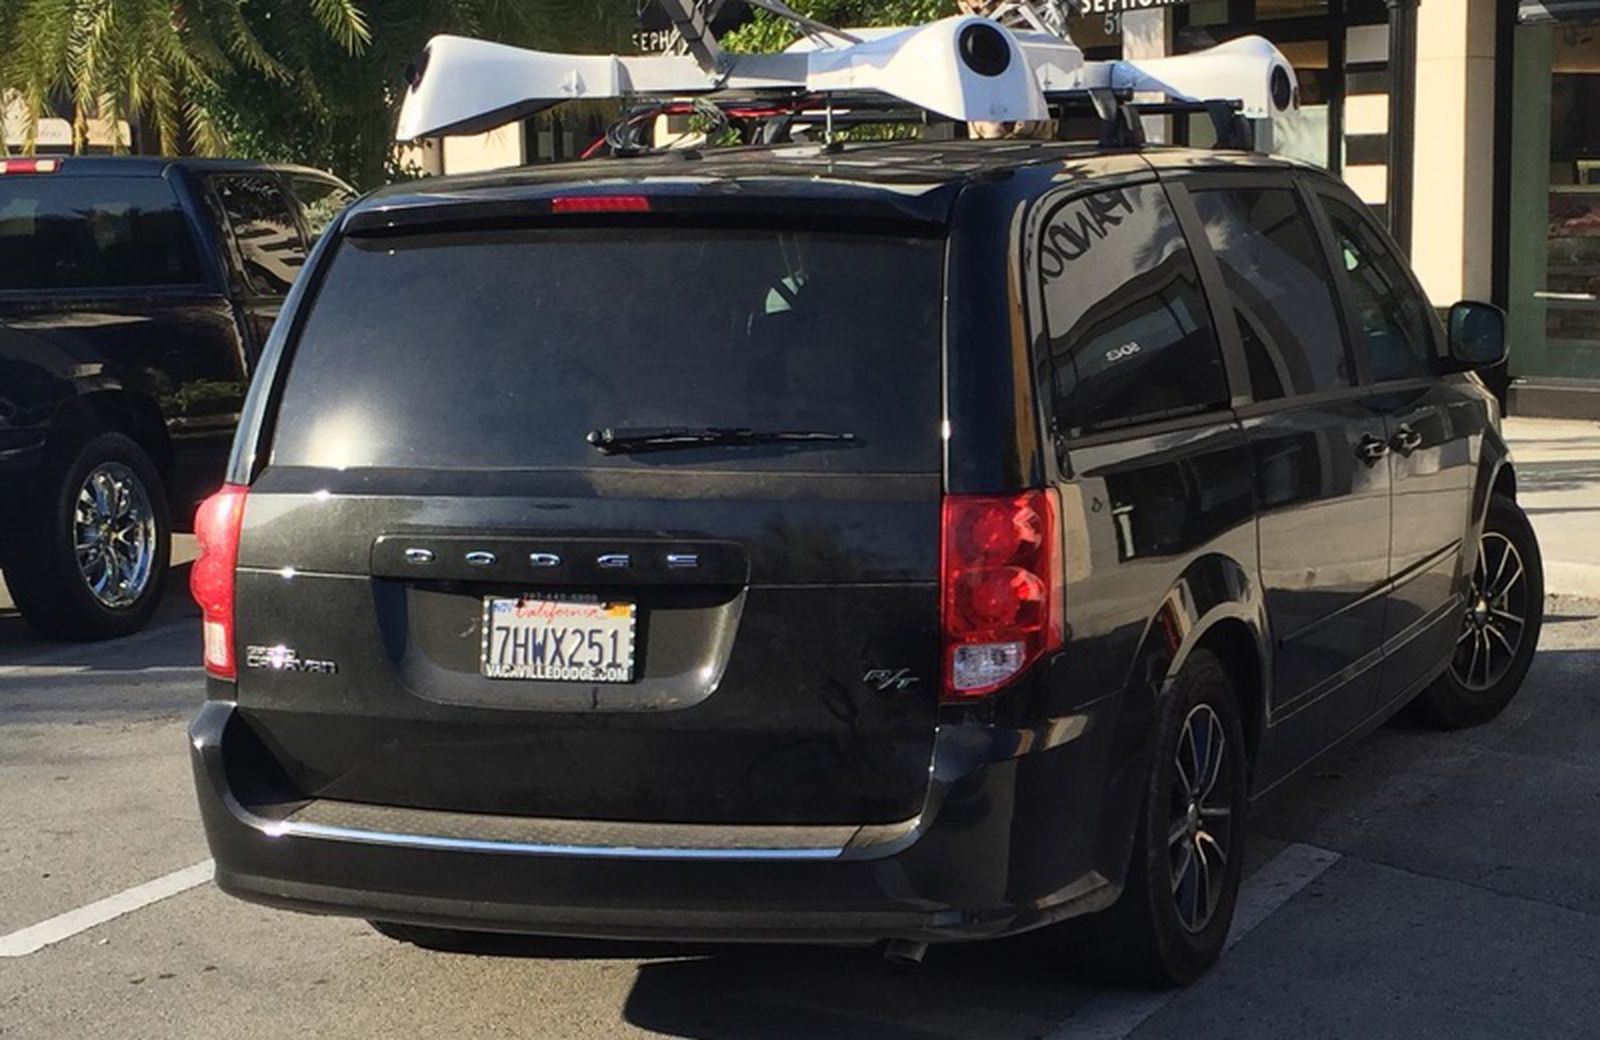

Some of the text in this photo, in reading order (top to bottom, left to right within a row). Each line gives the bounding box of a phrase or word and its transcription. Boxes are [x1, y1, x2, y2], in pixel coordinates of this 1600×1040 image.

[631, 29, 674, 51] SEPH
[404, 548, 698, 568] DODGE
[515, 600, 600, 624] California
[495, 626, 622, 668] 7HWX251
[485, 663, 629, 682] VACAVILLEDODGE.COM
